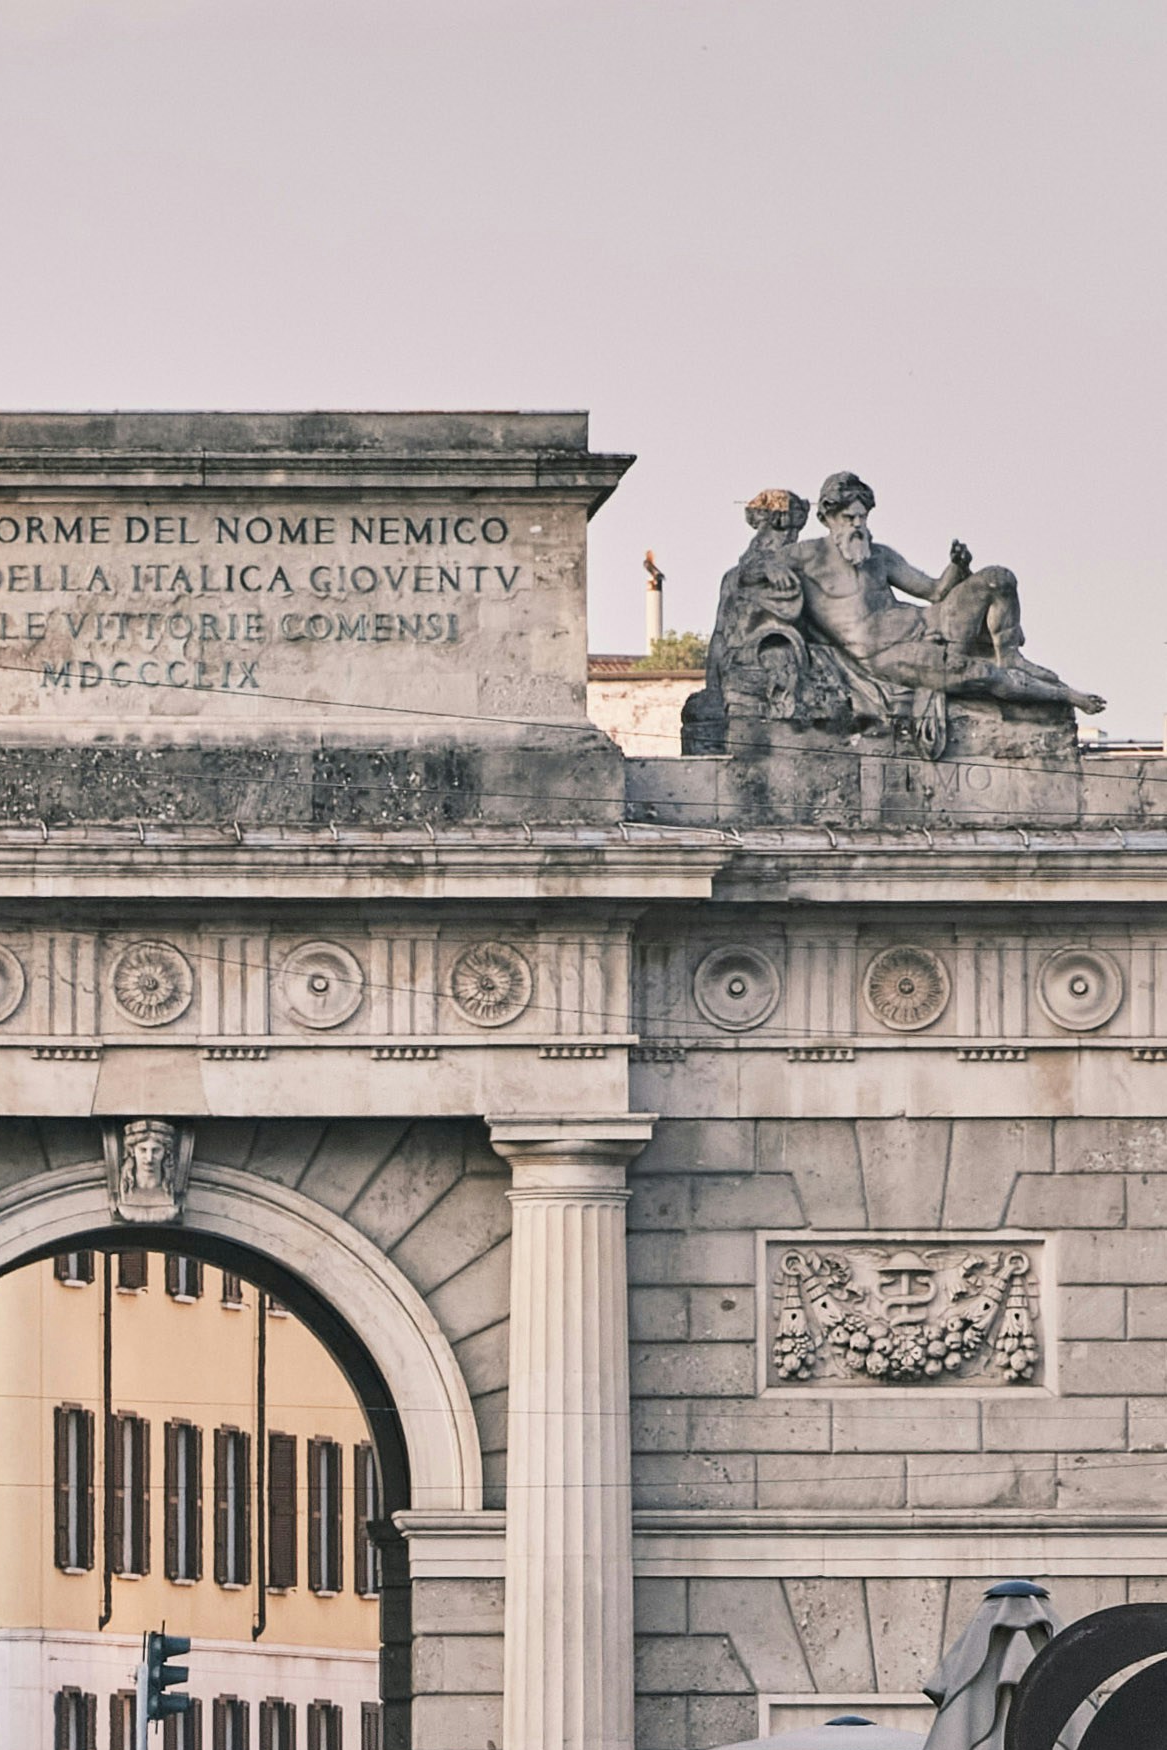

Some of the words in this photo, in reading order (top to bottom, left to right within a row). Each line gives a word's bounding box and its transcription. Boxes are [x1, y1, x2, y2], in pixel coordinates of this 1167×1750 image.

[125, 516, 200, 544] DEL
[215, 516, 335, 545] NOME
[350, 516, 509, 545] NEMICO
[132, 564, 294, 594] ITALICA
[309, 564, 521, 594] GIOVENTV
[62, 612, 266, 641] VITTORIE
[280, 612, 459, 643] COMENSI
[40, 660, 260, 689] MDCCCLIX
